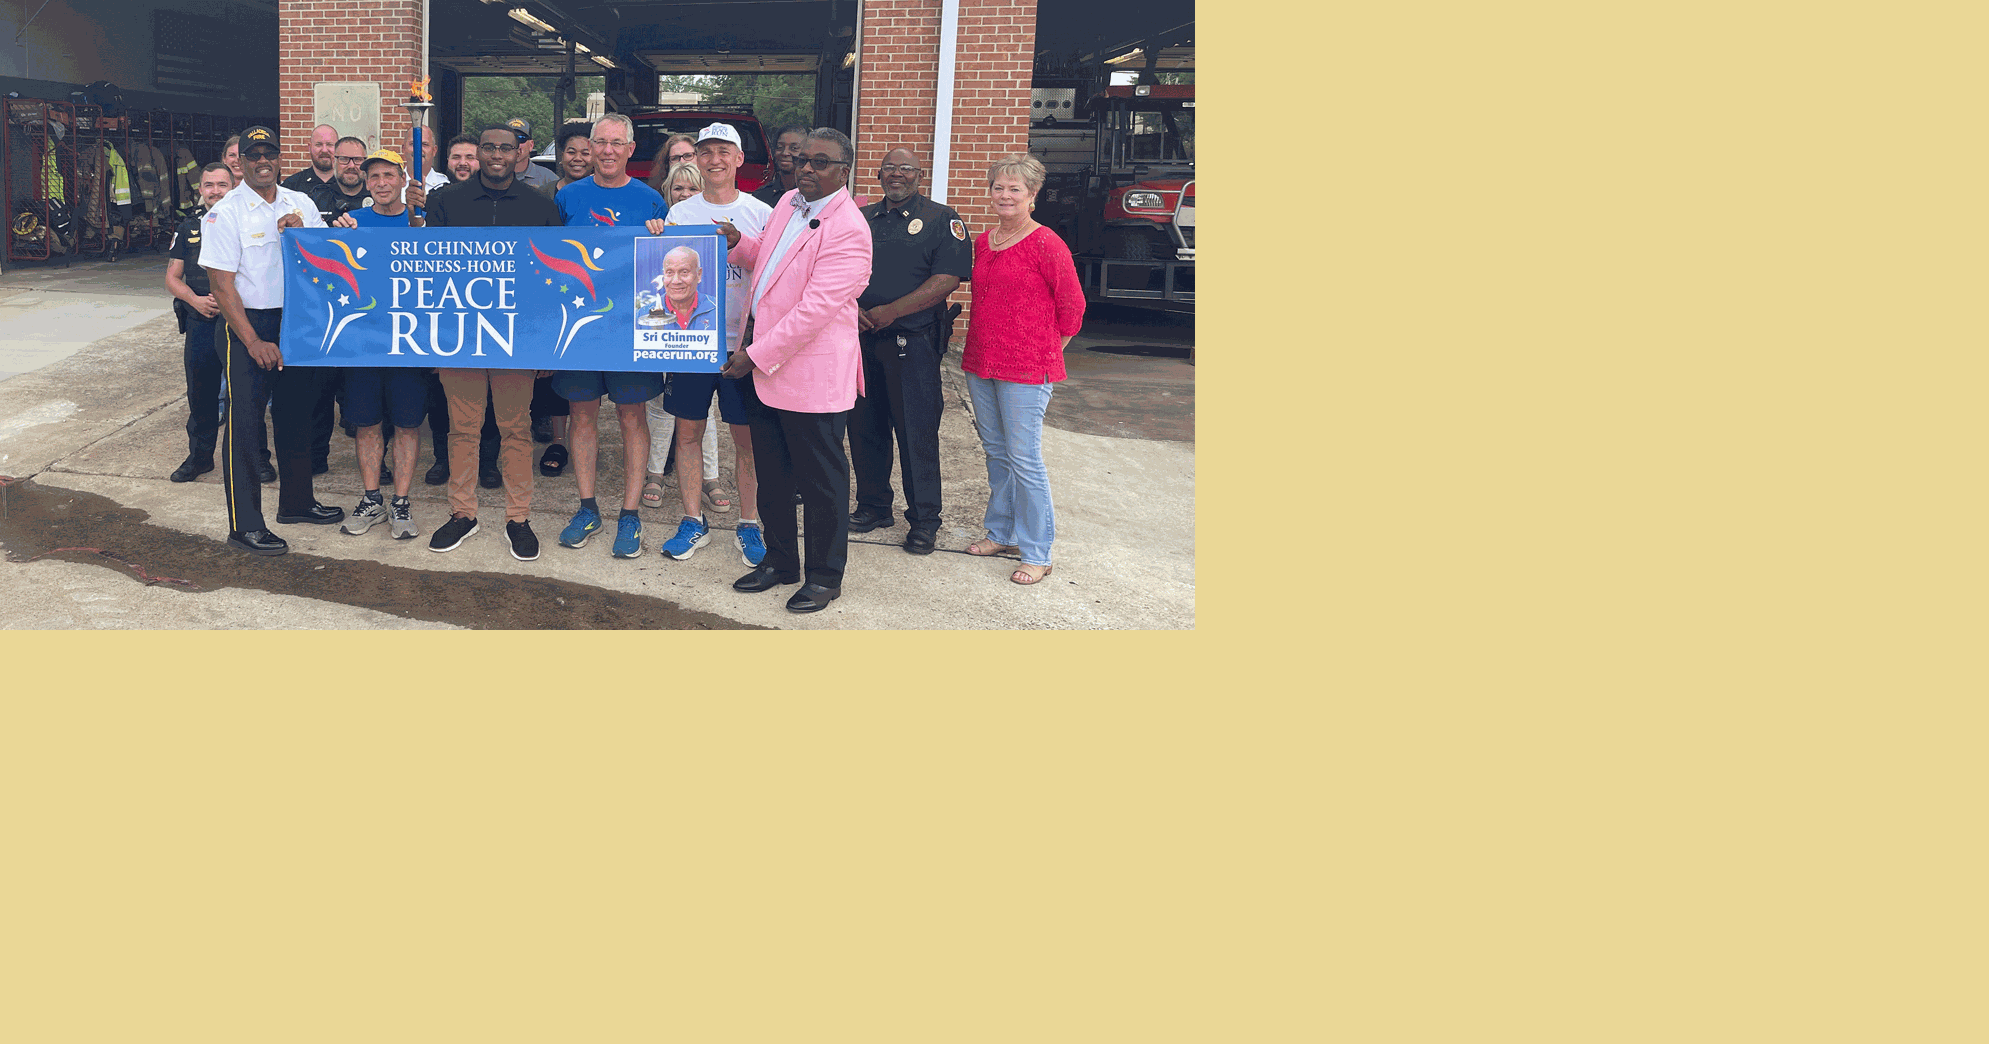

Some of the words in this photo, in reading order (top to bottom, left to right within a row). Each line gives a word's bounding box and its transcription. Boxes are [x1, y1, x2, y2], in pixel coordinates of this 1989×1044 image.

[332, 105, 362, 122] NO
[390, 241, 418, 255] SRI
[424, 241, 518, 256] CHINMOY
[390, 259, 516, 273] ONENESS-HOME
[389, 276, 517, 310] PEACE
[387, 311, 519, 357] RUN
[643, 332, 658, 342] Sri
[661, 332, 710, 345] Chinmoy
[633, 350, 718, 363] peacerun.org
